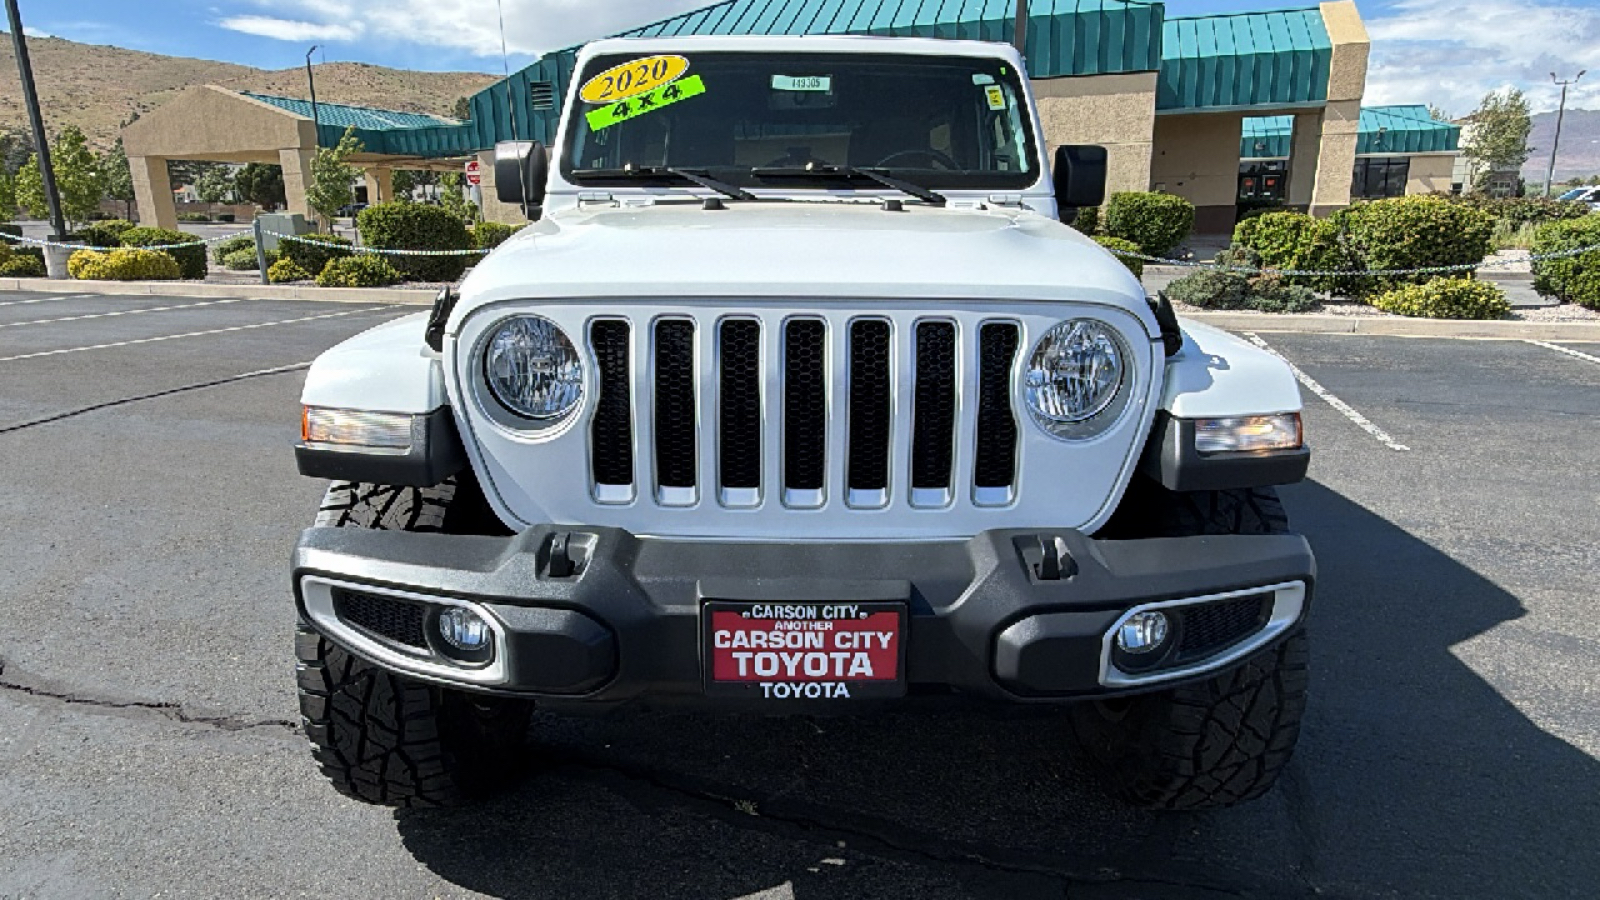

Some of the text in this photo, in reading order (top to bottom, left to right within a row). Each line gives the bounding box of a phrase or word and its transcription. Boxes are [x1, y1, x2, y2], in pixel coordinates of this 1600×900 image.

[599, 58, 668, 99] 2020
[752, 604, 859, 620] CARSON CITY
[774, 621, 834, 631] ANOTHER
[714, 630, 893, 650] CARSON CITY
[732, 651, 874, 677] TOYOTA
[760, 682, 851, 699] TOYOTA
